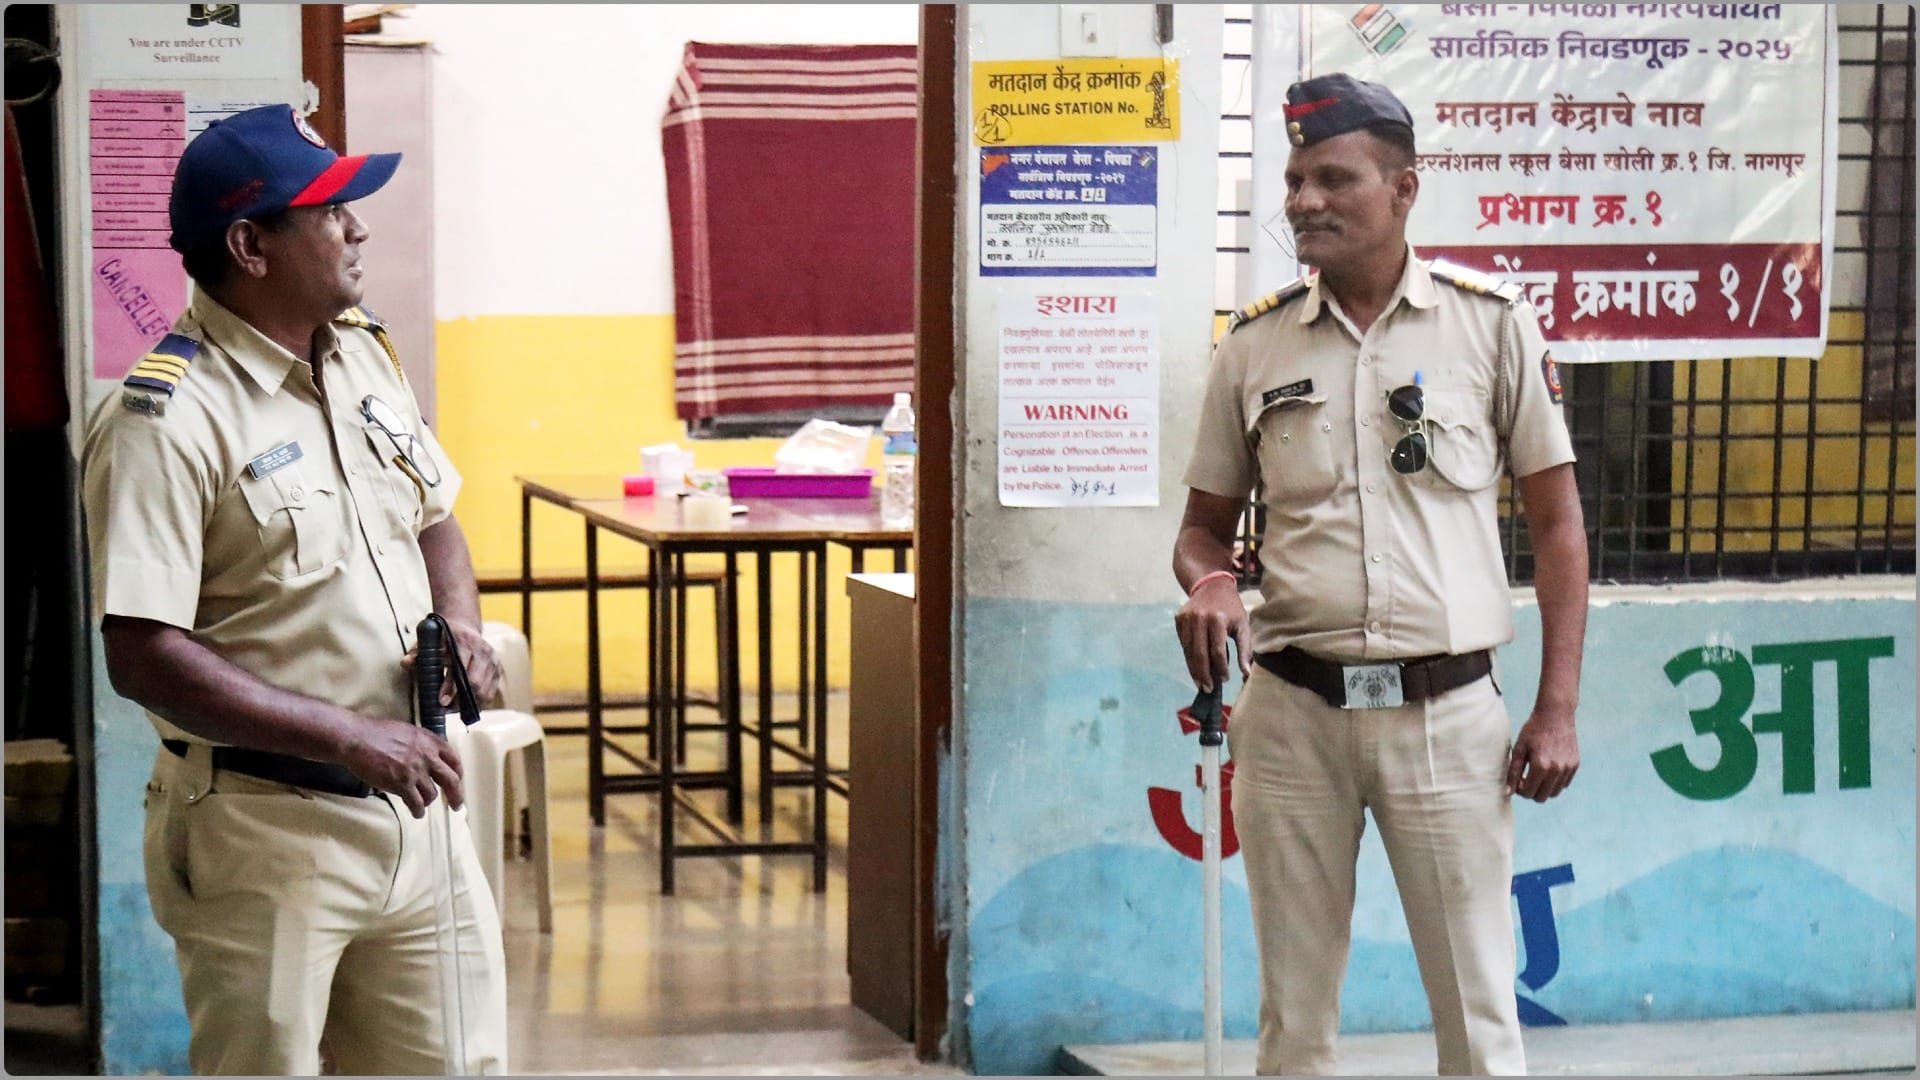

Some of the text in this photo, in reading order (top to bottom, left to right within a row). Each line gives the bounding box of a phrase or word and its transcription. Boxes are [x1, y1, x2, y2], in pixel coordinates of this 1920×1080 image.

[129, 37, 244, 48] You are under CCTV
[1429, 30, 1550, 58] सार्वत्रिक
[1557, 31, 1689, 68] निवडणूक
[1718, 39, 1791, 60] २०२५
[153, 52, 221, 63] Surveillance
[988, 64, 1141, 93] मतदान केंद्र क्रमांक
[991, 102, 1138, 117] POLLING STATION No.
[1435, 92, 1704, 134] मतदान केंद्राचे नाव
[1416, 148, 1501, 173] टरनॅशनल
[1508, 154, 1551, 177] स्कूल
[1559, 146, 1596, 171] बेसा
[1604, 146, 1655, 172] खोली
[1708, 147, 1736, 172] जि.
[1745, 154, 1806, 177] नागपूर
[1476, 192, 1580, 230] प्रभाग
[1571, 252, 1699, 322] क्रमांक
[1036, 295, 1117, 316] इशारा
[1024, 404, 1128, 420] WARNING
[1004, 430, 1060, 440] Personation
[1085, 430, 1123, 439] Election
[1130, 430, 1138, 439] is
[1004, 447, 1056, 458] Cognizable
[1003, 463, 1148, 473] are Liable to Immediate Arrest
[1004, 481, 1015, 493] by
[1017, 481, 1031, 491] the
[1650, 636, 1895, 801] आ
